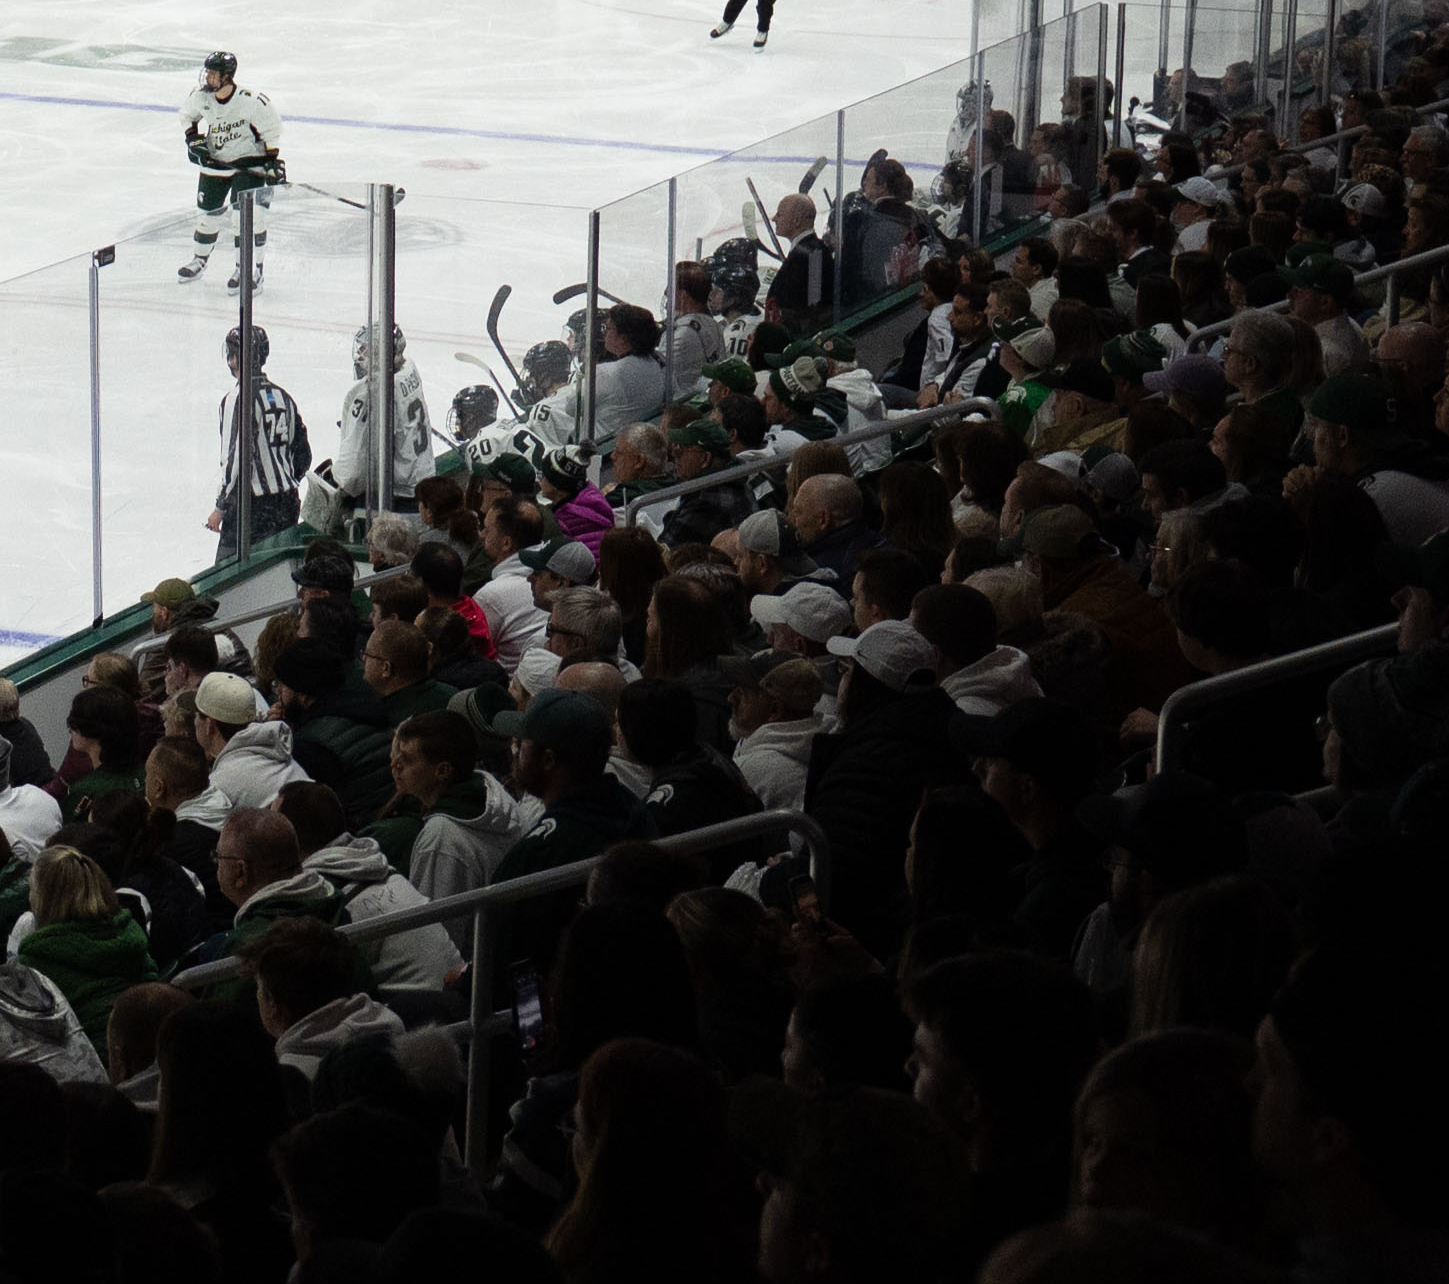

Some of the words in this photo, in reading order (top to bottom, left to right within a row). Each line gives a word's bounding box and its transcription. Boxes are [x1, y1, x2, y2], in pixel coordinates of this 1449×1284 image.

[730, 337, 748, 356] 10
[533, 403, 552, 423] 15
[264, 411, 289, 445] 74
[468, 439, 492, 461] 20
